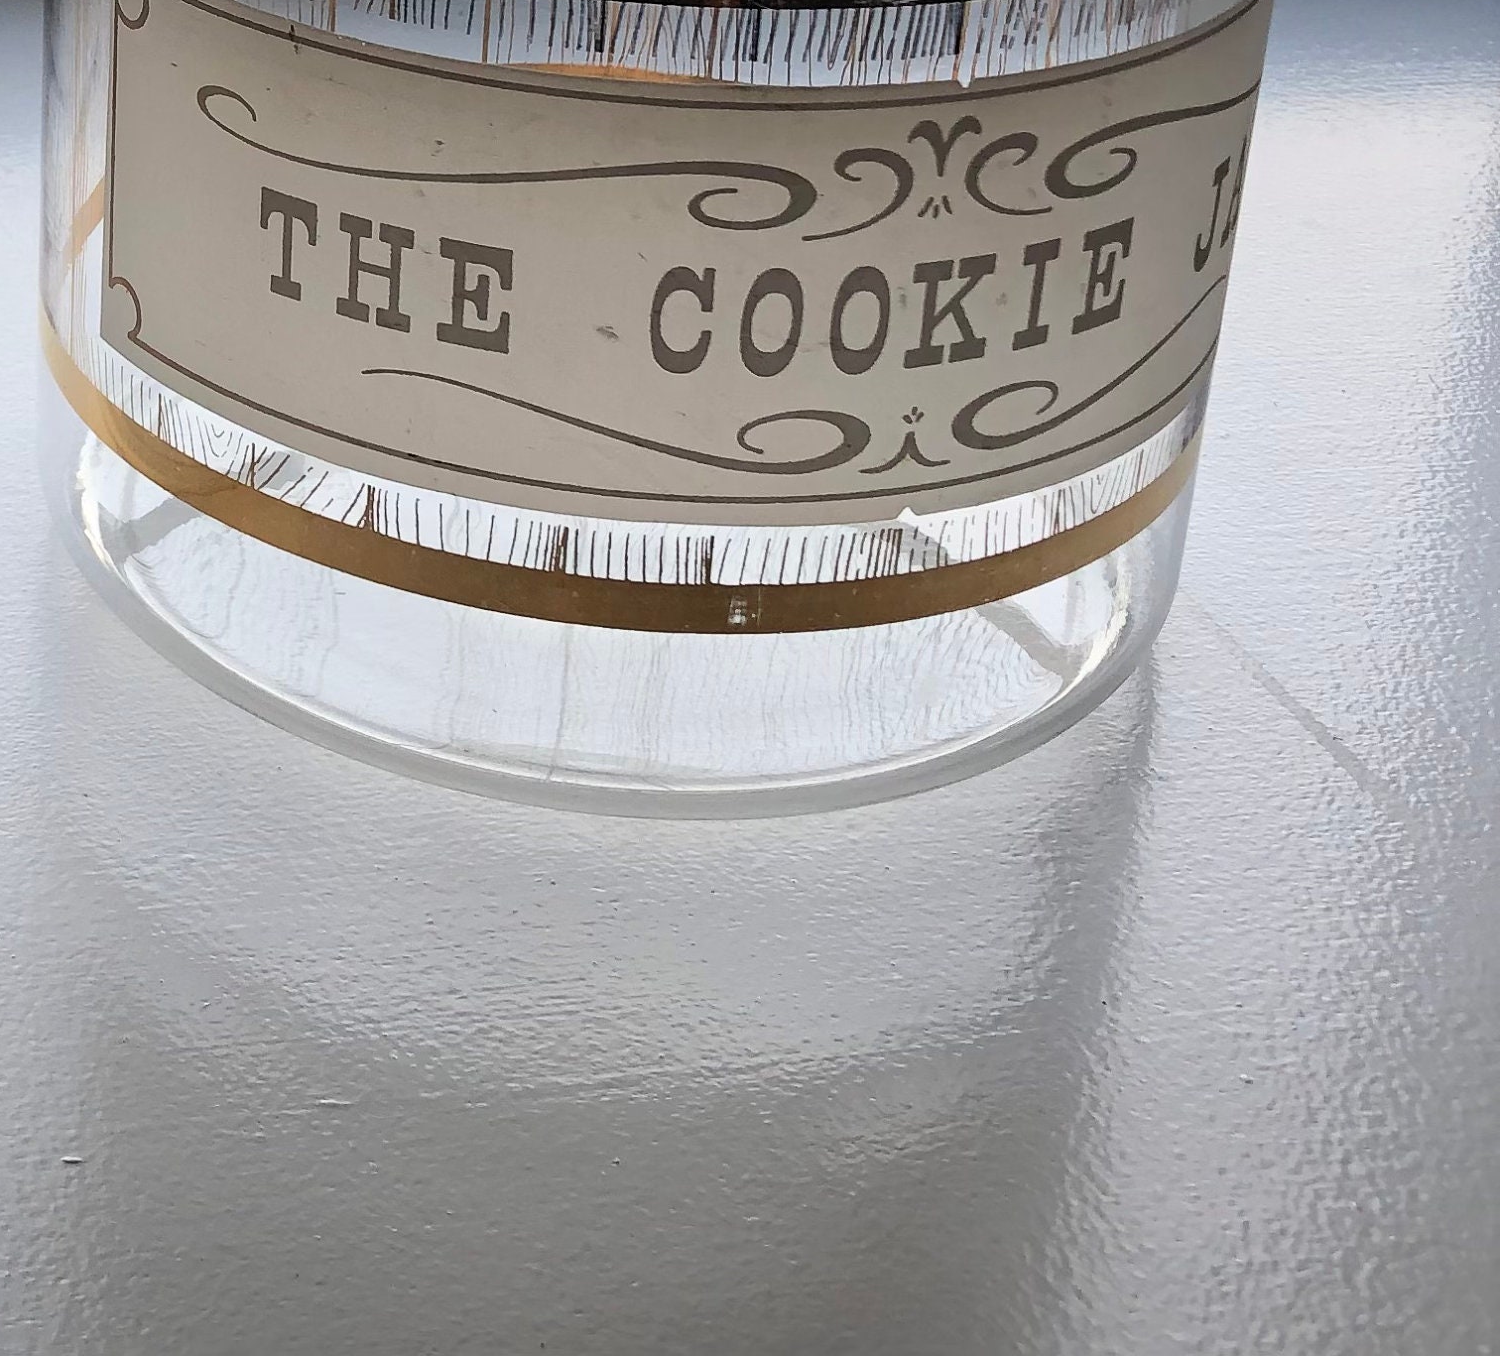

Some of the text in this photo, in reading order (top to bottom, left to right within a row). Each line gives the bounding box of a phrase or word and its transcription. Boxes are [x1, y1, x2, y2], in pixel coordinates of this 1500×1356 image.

[259, 130, 1248, 378] THE COOKIE JA
